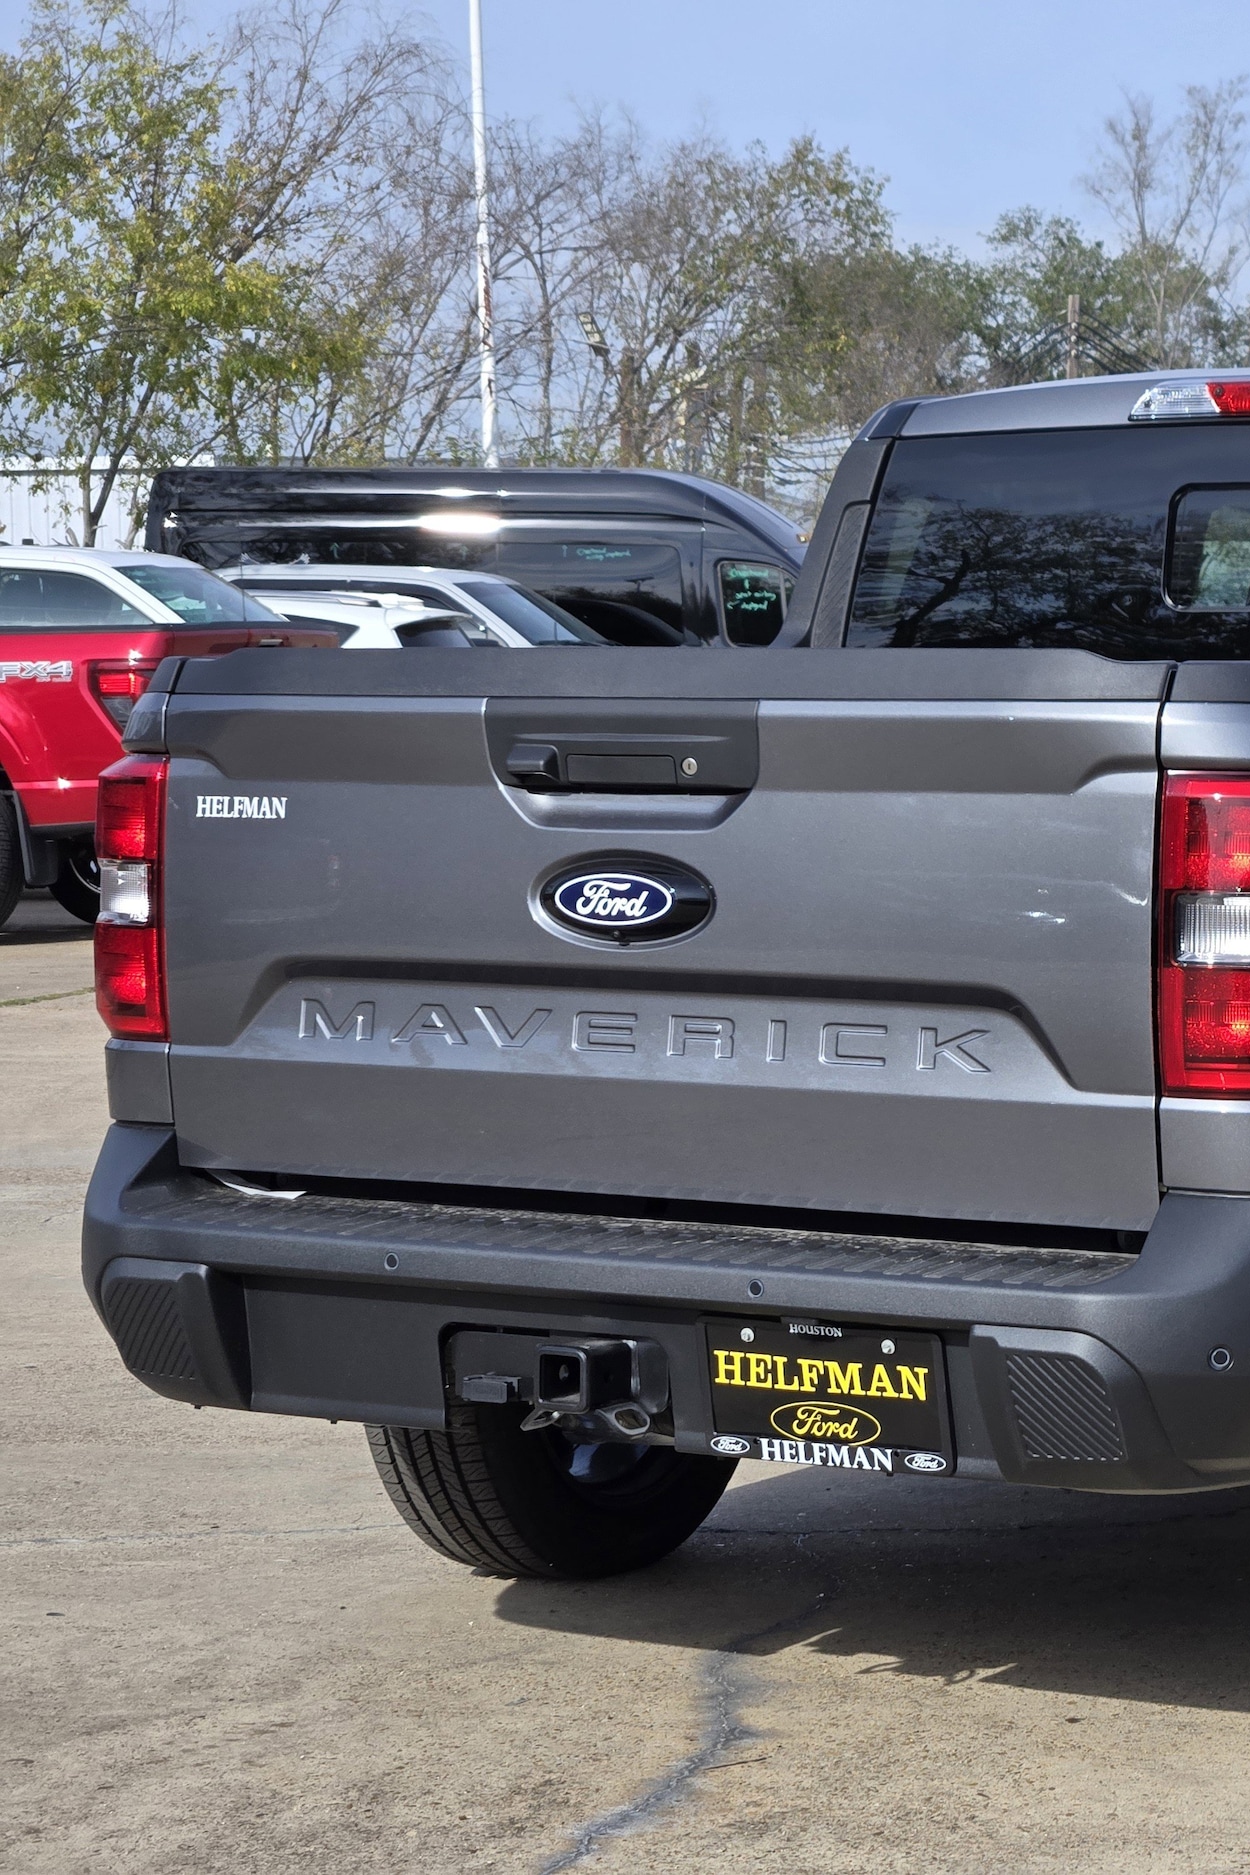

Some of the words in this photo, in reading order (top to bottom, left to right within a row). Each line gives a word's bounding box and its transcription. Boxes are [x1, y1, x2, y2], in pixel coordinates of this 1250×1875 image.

[0, 660, 73, 683] FX4
[195, 796, 288, 819] HELFMAN
[575, 880, 650, 918] Ford
[298, 998, 992, 1075] MAVERICK
[789, 1323, 843, 1338] HOUSTON
[713, 1350, 929, 1401] HELFMAN
[792, 1406, 860, 1440] Ford
[717, 1438, 743, 1452] Ford
[759, 1437, 894, 1472] HELFMAN
[911, 1455, 939, 1469] Ford
